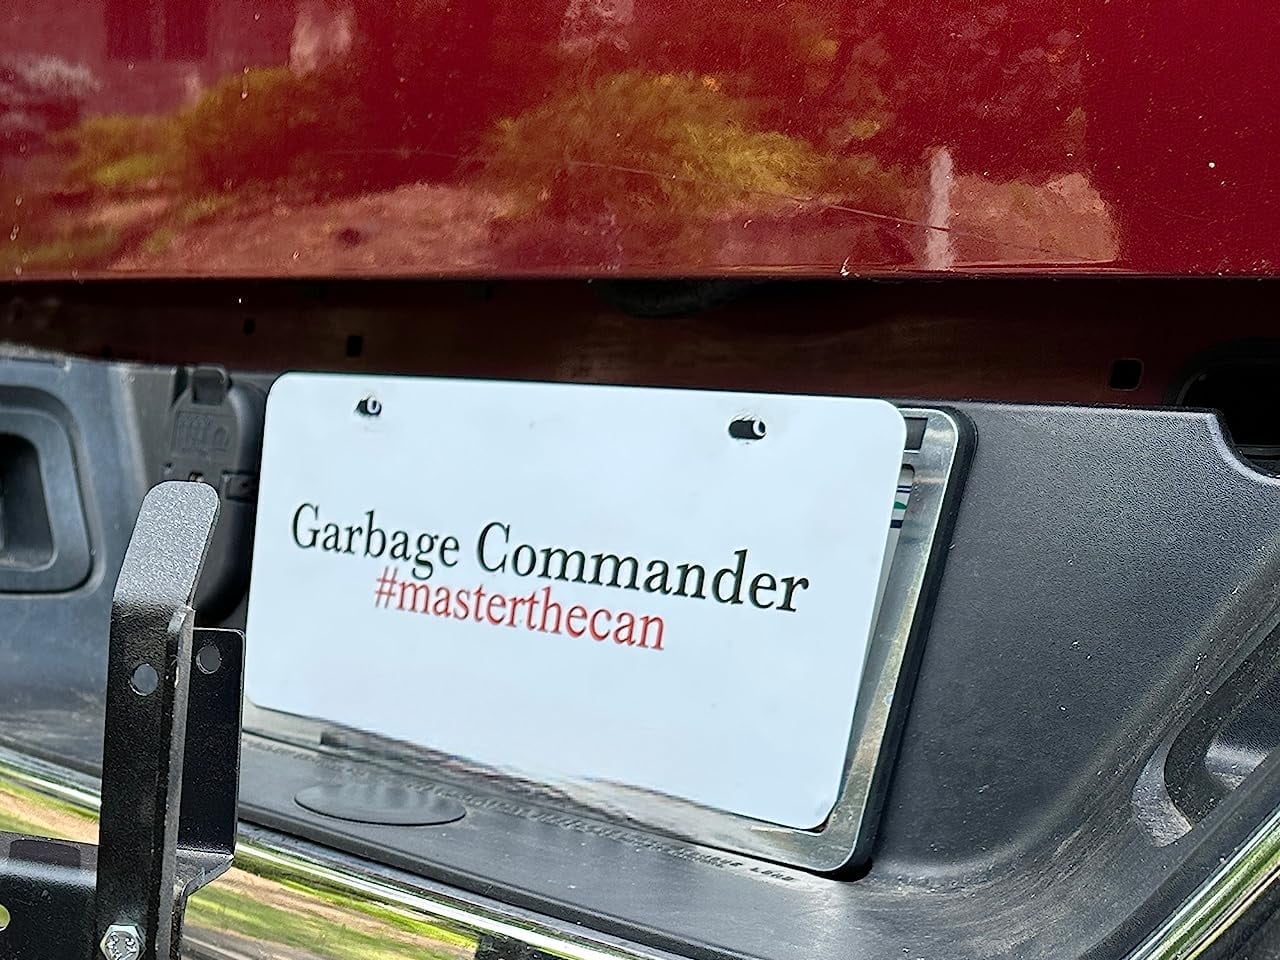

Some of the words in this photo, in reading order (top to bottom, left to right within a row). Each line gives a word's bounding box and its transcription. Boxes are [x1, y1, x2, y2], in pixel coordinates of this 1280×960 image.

[292, 502, 460, 581] Garbage
[476, 521, 809, 612] Commander
[374, 565, 665, 651] #masterthecan
